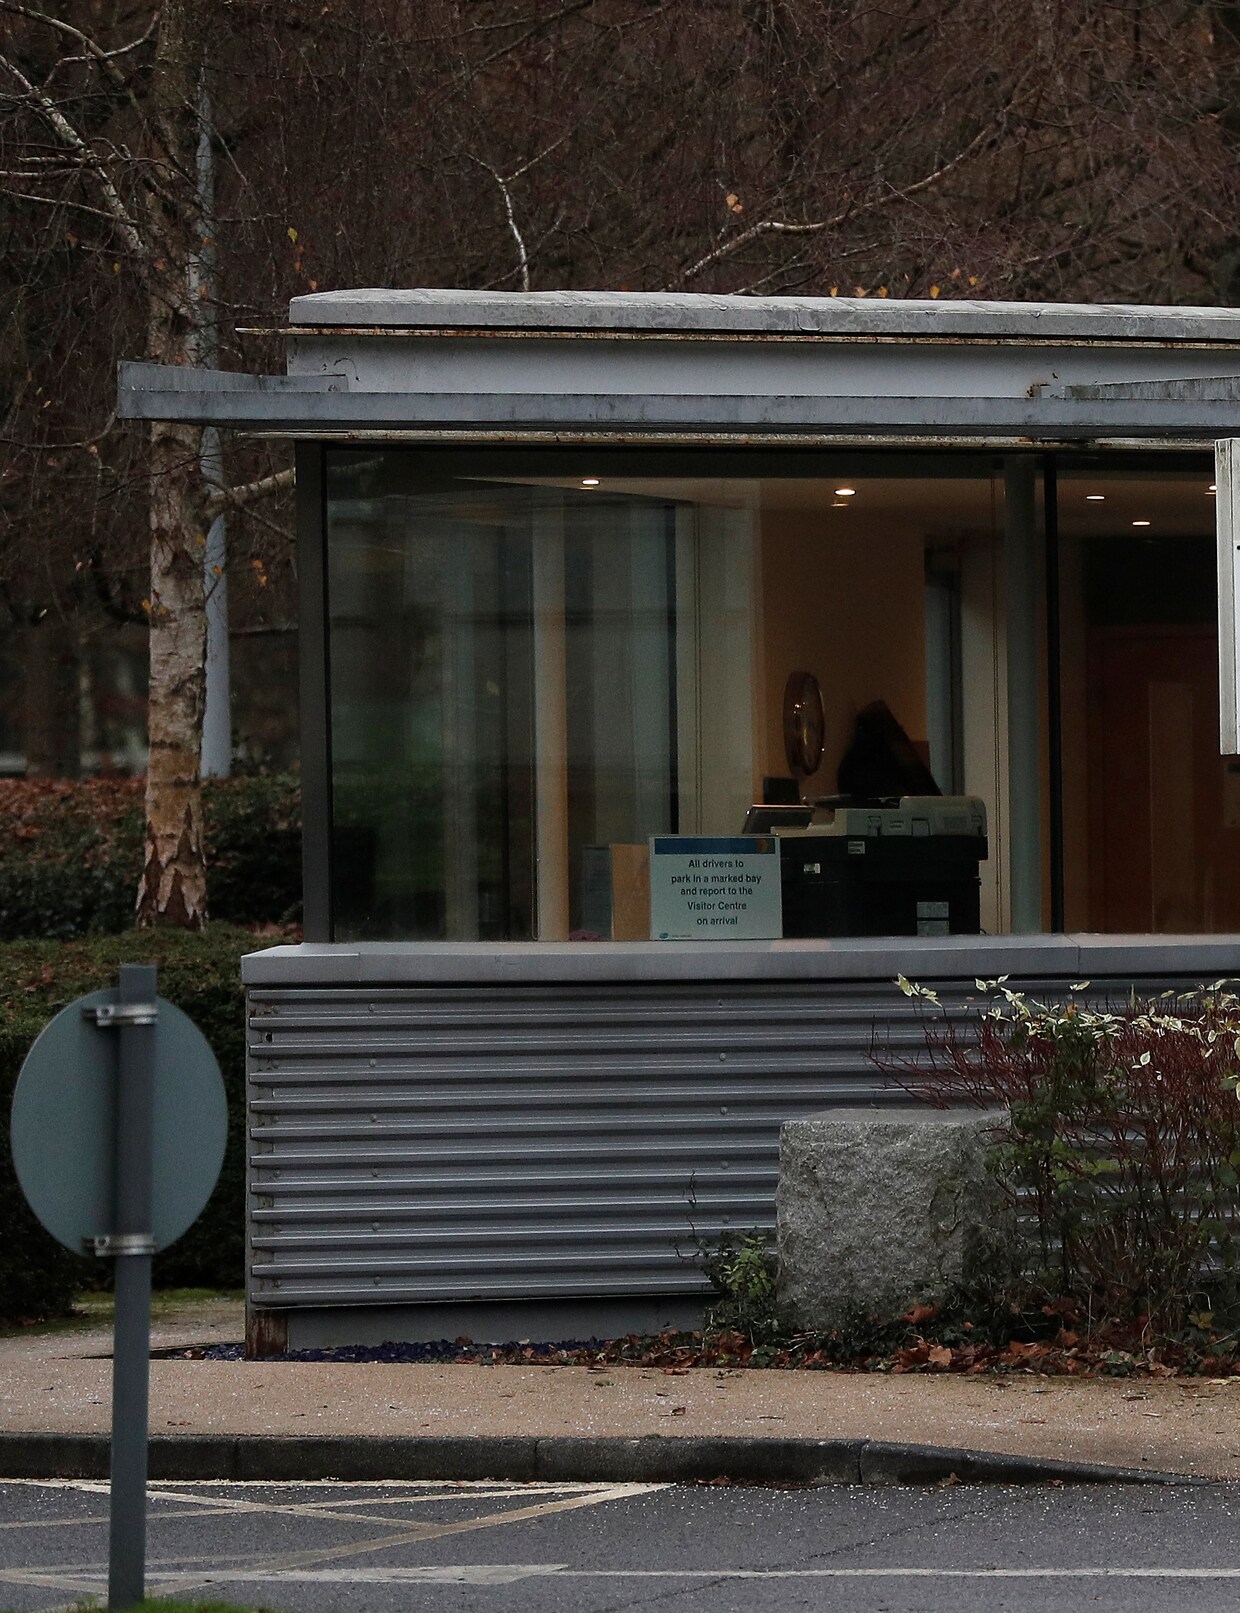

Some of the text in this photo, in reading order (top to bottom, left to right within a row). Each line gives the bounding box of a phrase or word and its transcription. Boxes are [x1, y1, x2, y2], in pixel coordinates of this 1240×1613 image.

[688, 859, 744, 868] All drivers to
[671, 874, 691, 884] park
[693, 874, 702, 883] in
[711, 874, 743, 883] marked
[745, 874, 762, 885] bay
[680, 887, 753, 897] and report to the
[687, 901, 747, 910] Visitor Centre
[710, 916, 738, 925] arrival
